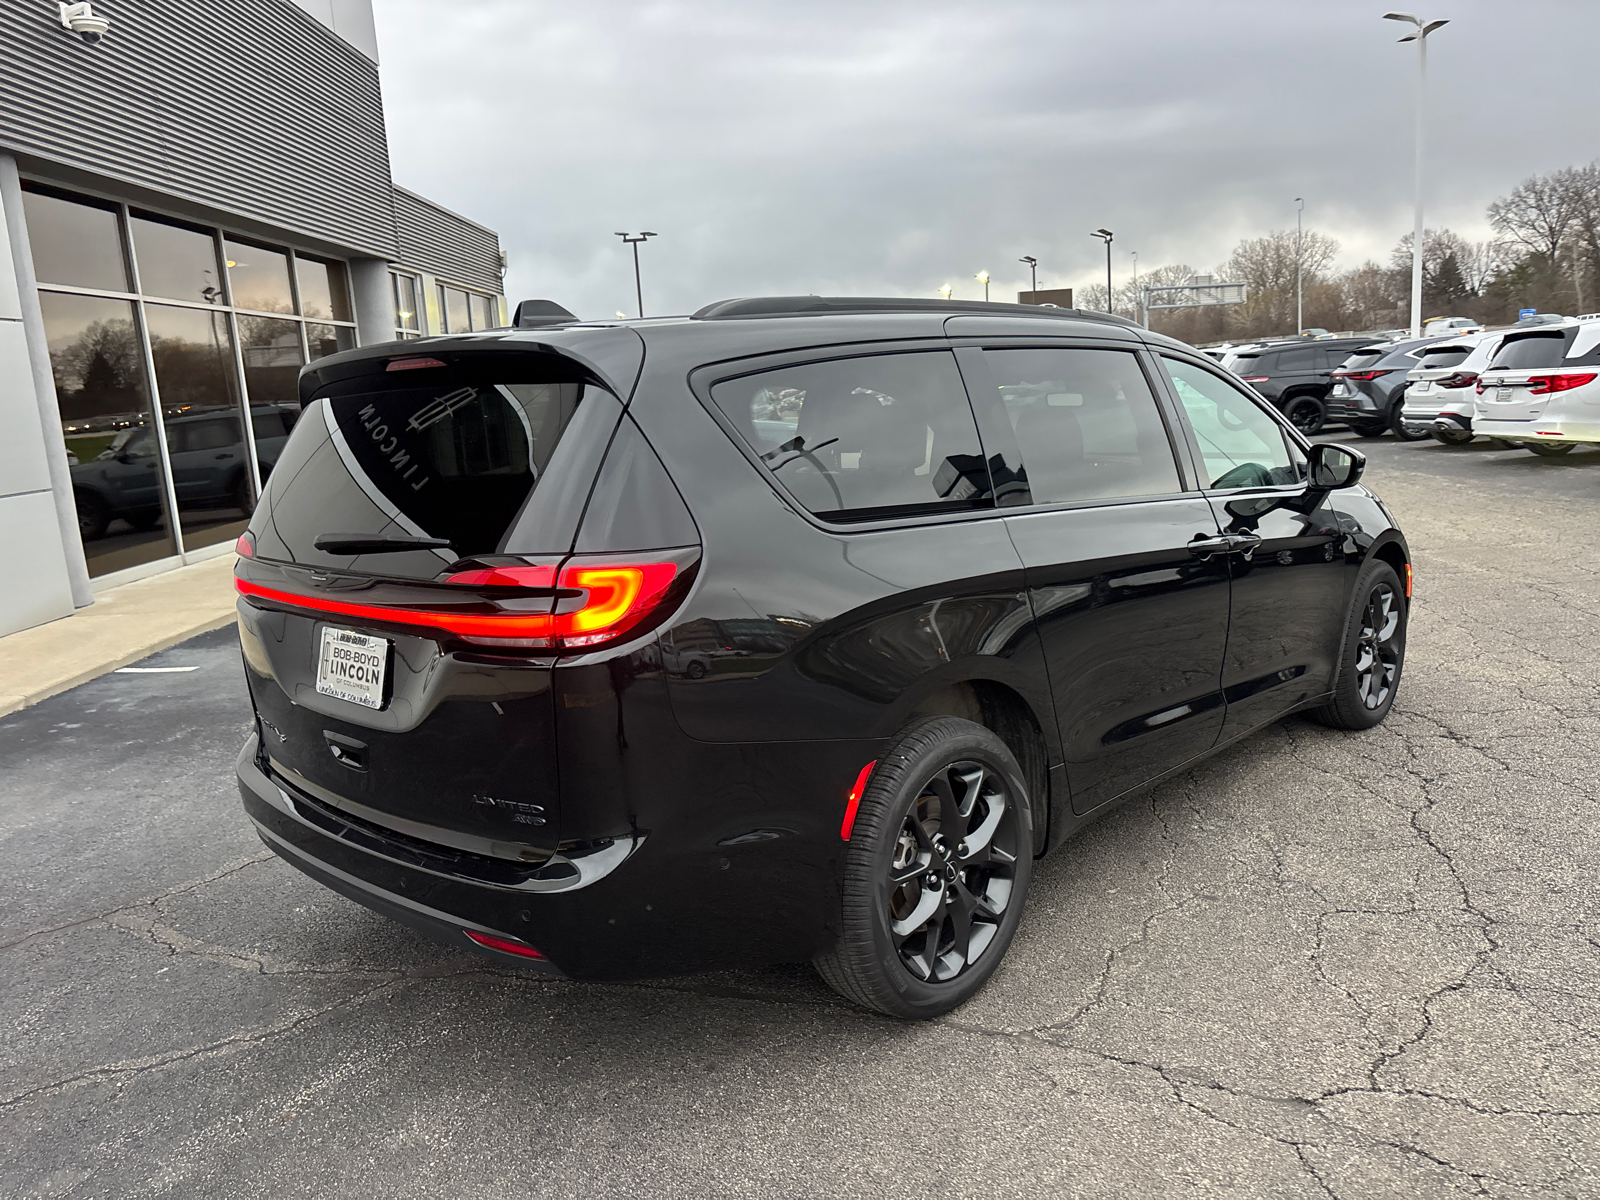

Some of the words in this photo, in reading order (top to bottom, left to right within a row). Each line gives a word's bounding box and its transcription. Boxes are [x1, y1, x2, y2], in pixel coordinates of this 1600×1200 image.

[333, 647, 380, 667] BOB-BOYD
[330, 660, 380, 685] LINCOLN
[343, 680, 370, 691] COLUMBUS
[473, 794, 545, 812] LIMITED
